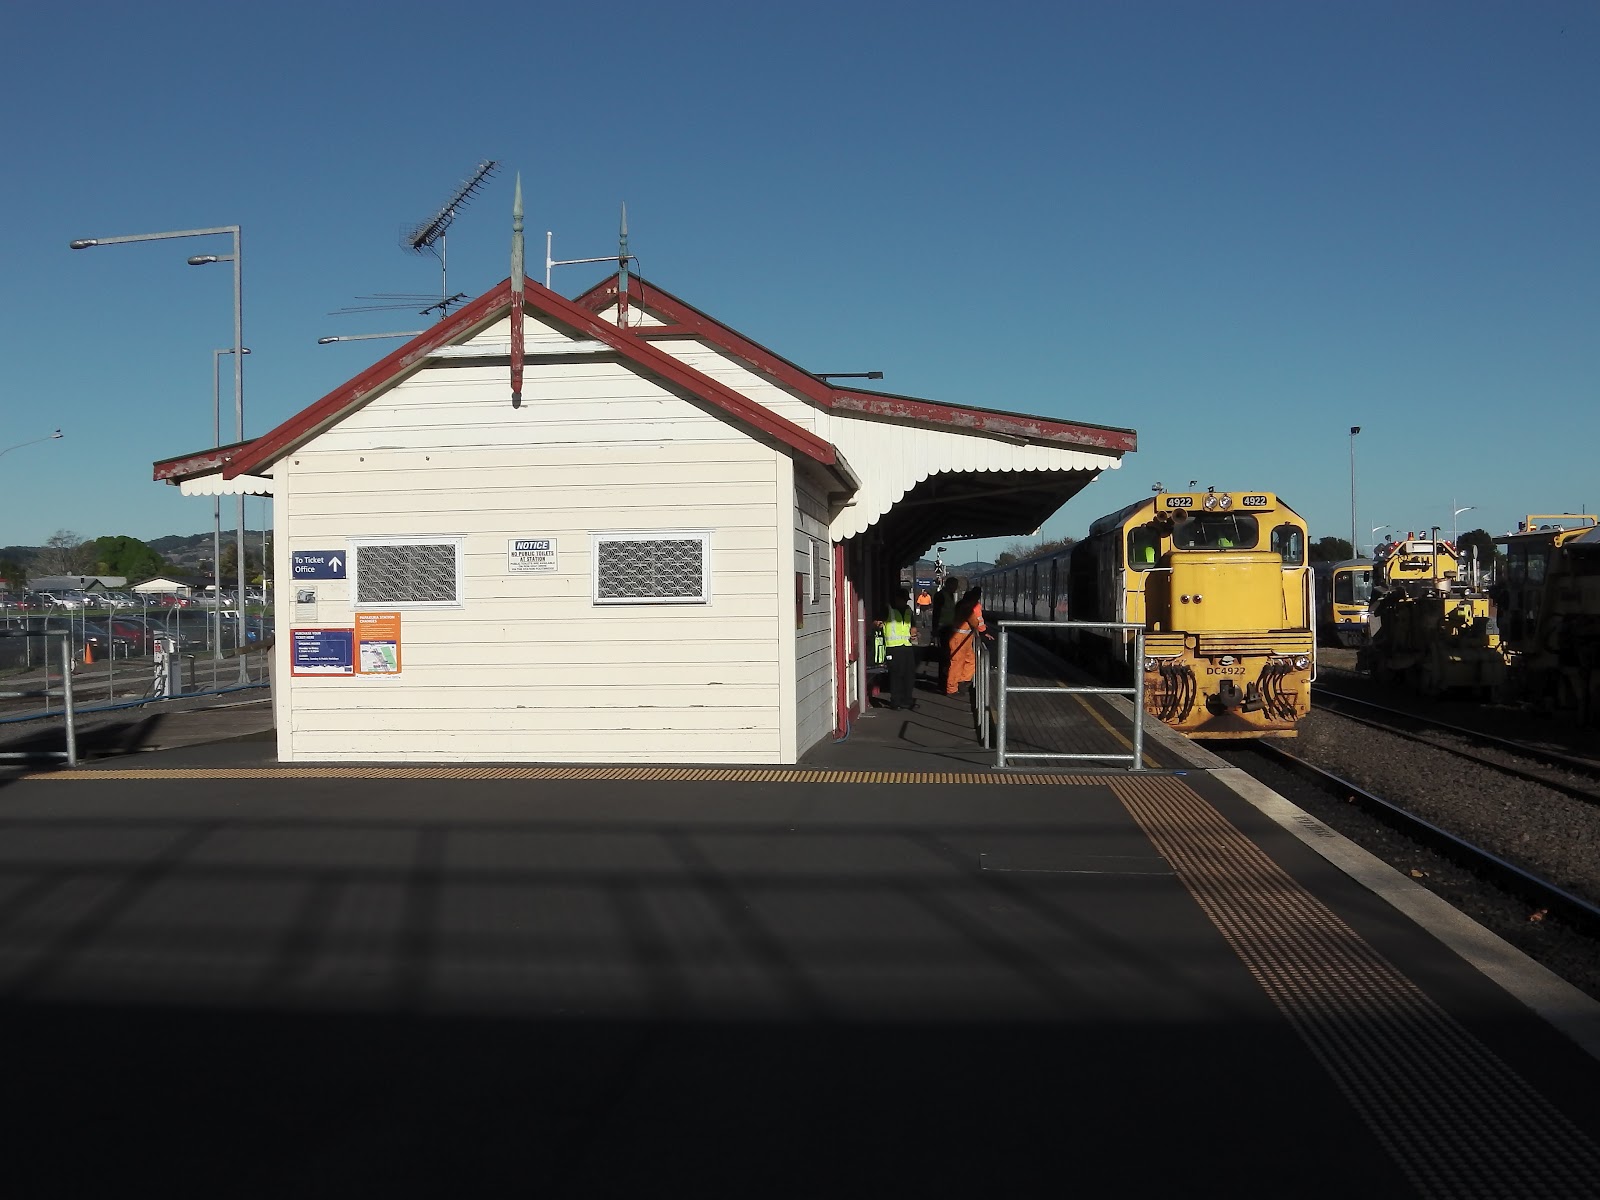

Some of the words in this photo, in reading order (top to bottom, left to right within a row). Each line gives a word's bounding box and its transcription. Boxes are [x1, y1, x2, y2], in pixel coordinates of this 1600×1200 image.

[1168, 498, 1192, 507] 4922
[1244, 497, 1266, 506] 4922
[516, 541, 549, 549] NOTICE
[294, 556, 303, 564] To
[304, 556, 325, 564] Ticket
[294, 565, 316, 573] Office
[1206, 667, 1246, 675] DC4922
